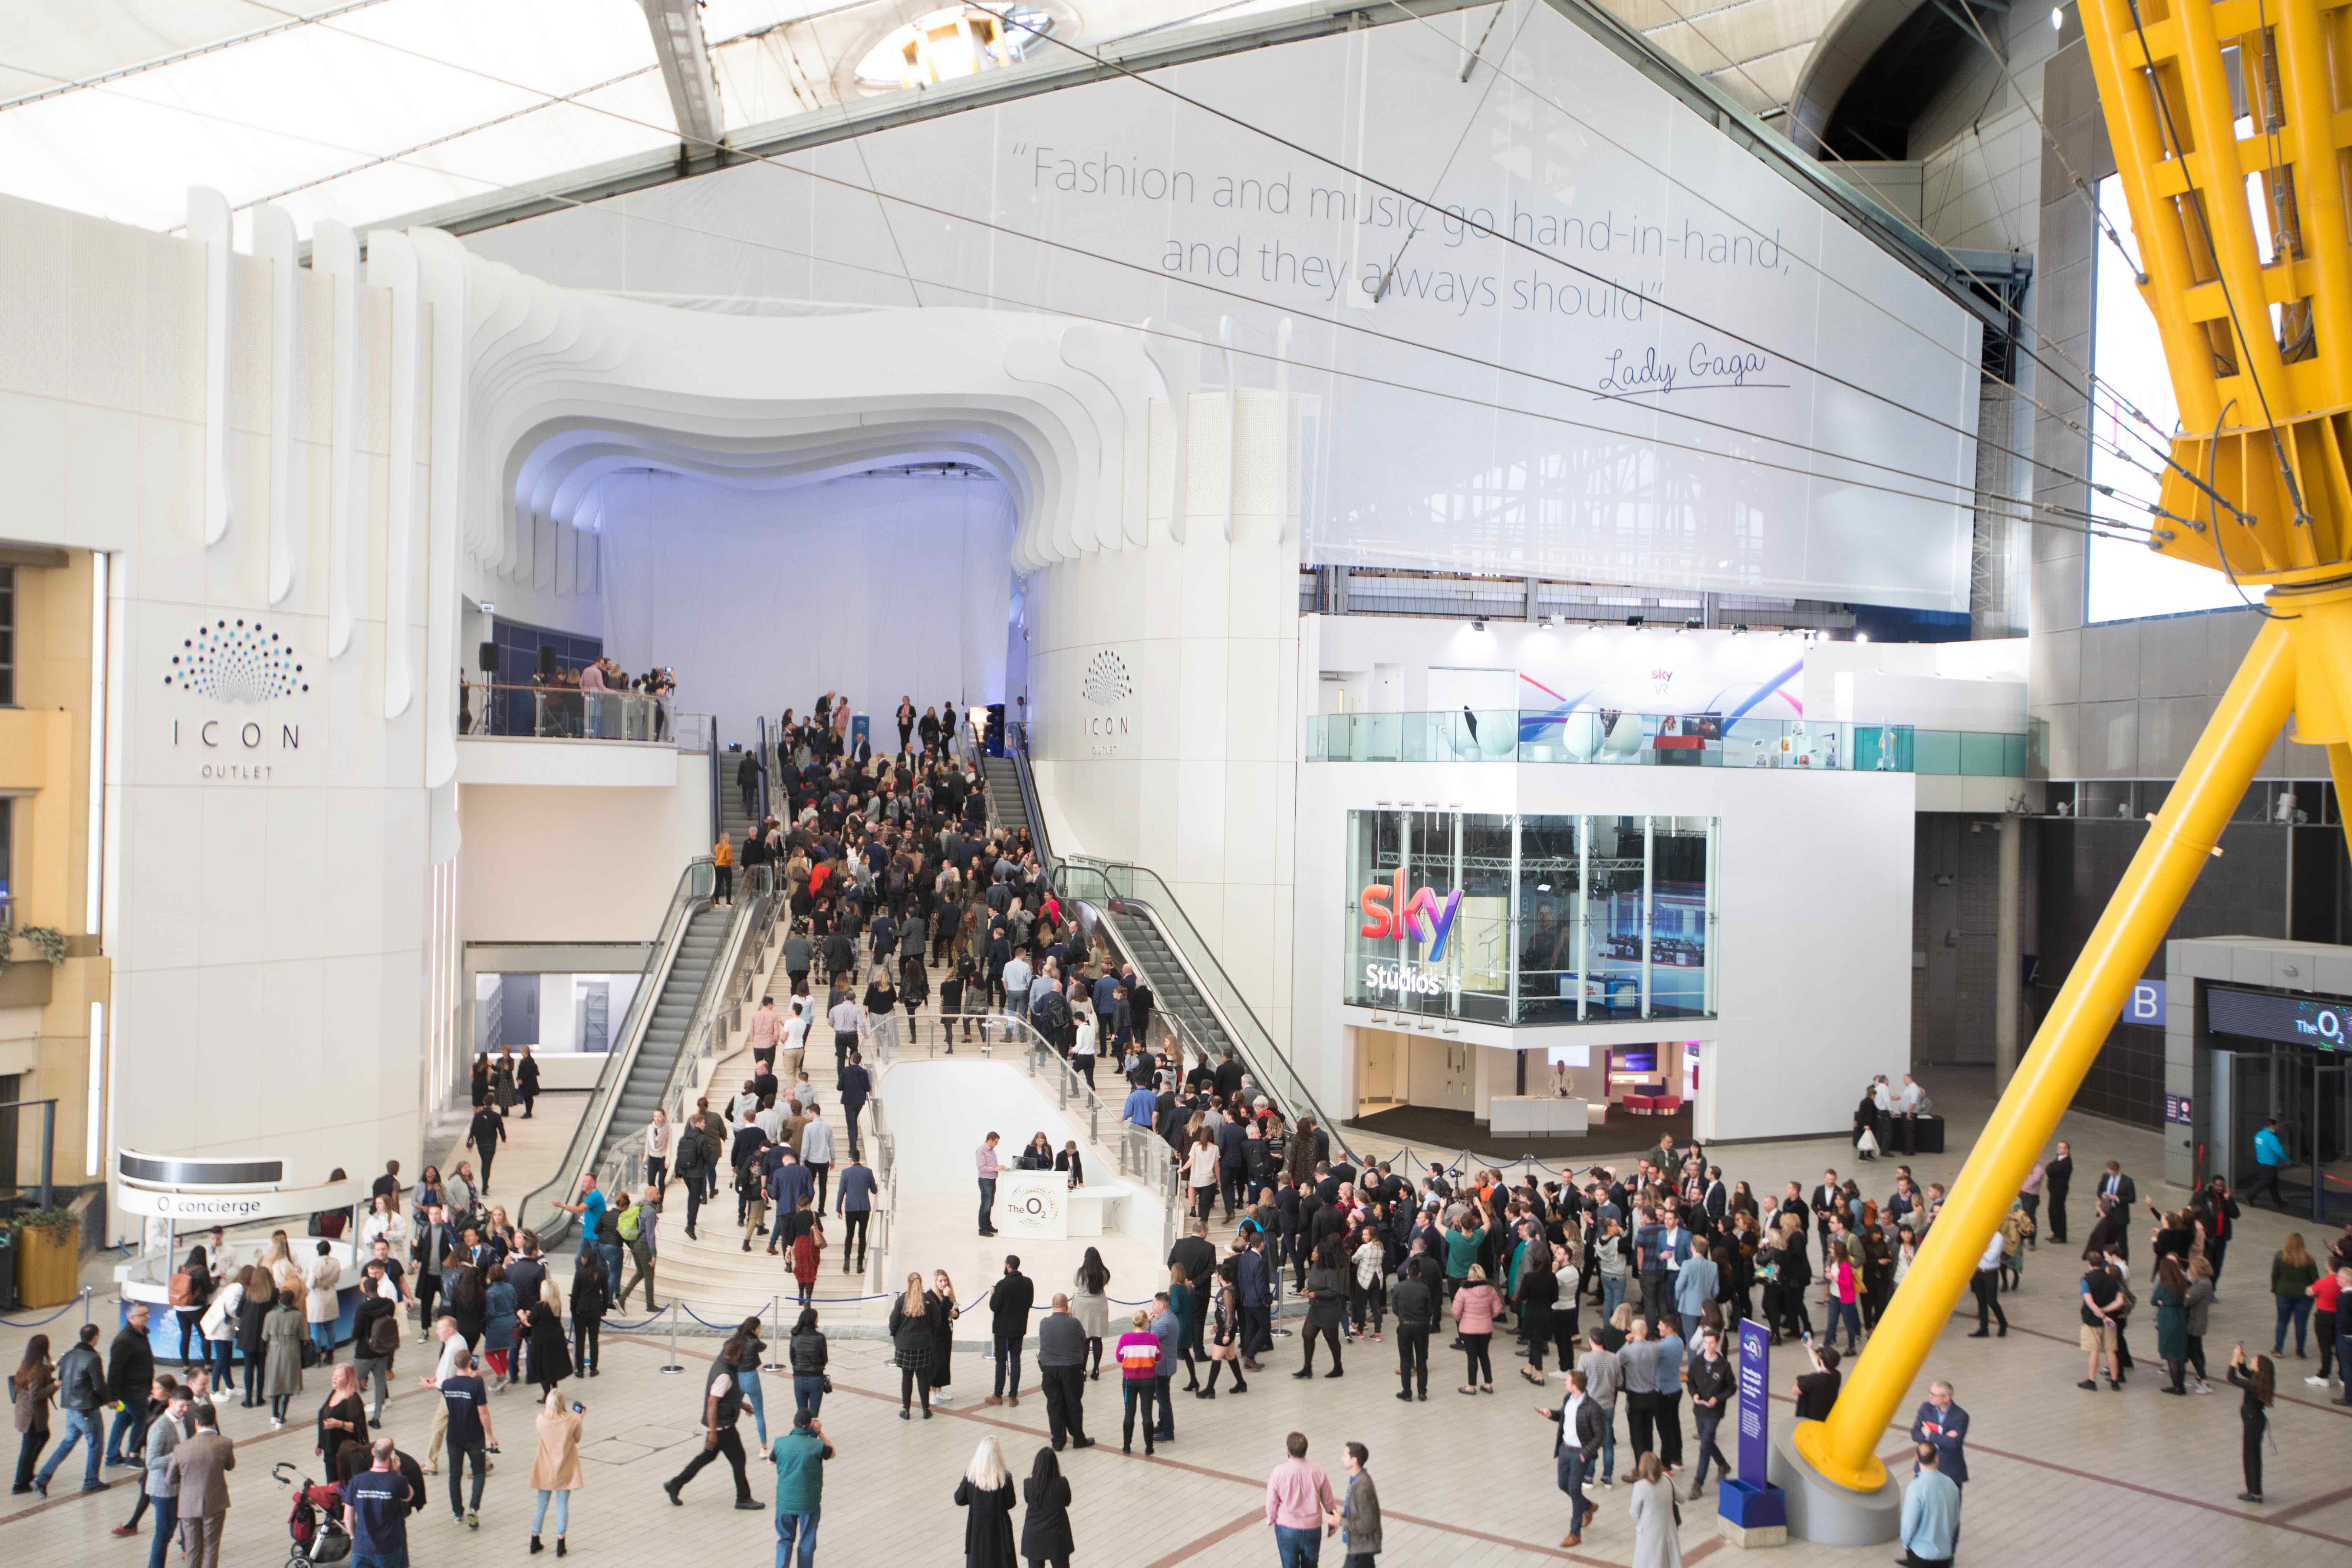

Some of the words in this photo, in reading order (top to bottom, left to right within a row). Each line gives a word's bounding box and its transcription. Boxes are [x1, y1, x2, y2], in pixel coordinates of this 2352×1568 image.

[1213, 172, 1291, 214] and
[1311, 188, 1425, 231] music
[1443, 204, 1494, 247] go
[1513, 199, 1789, 276] hand-in-hand,
[1162, 235, 1240, 277] and
[1258, 239, 1347, 301] they
[1362, 253, 1496, 316] always
[1599, 347, 1676, 393] Lady
[1689, 342, 1766, 386] Gaga
[1651, 667, 1673, 682] sky
[1654, 683, 1668, 694] VR
[173, 719, 299, 749] ICON
[1084, 717, 1128, 735] ICON
[1092, 746, 1117, 755] OUTLET
[201, 764, 273, 778] OUTLET
[1361, 867, 1465, 962] sky
[1366, 963, 1439, 995] Studios
[2134, 986, 2157, 1018] B
[2294, 1019, 2319, 1034] The
[179, 1199, 260, 1215] concierge
[1008, 1204, 1024, 1214] The
[1026, 1197, 1046, 1218] O2
